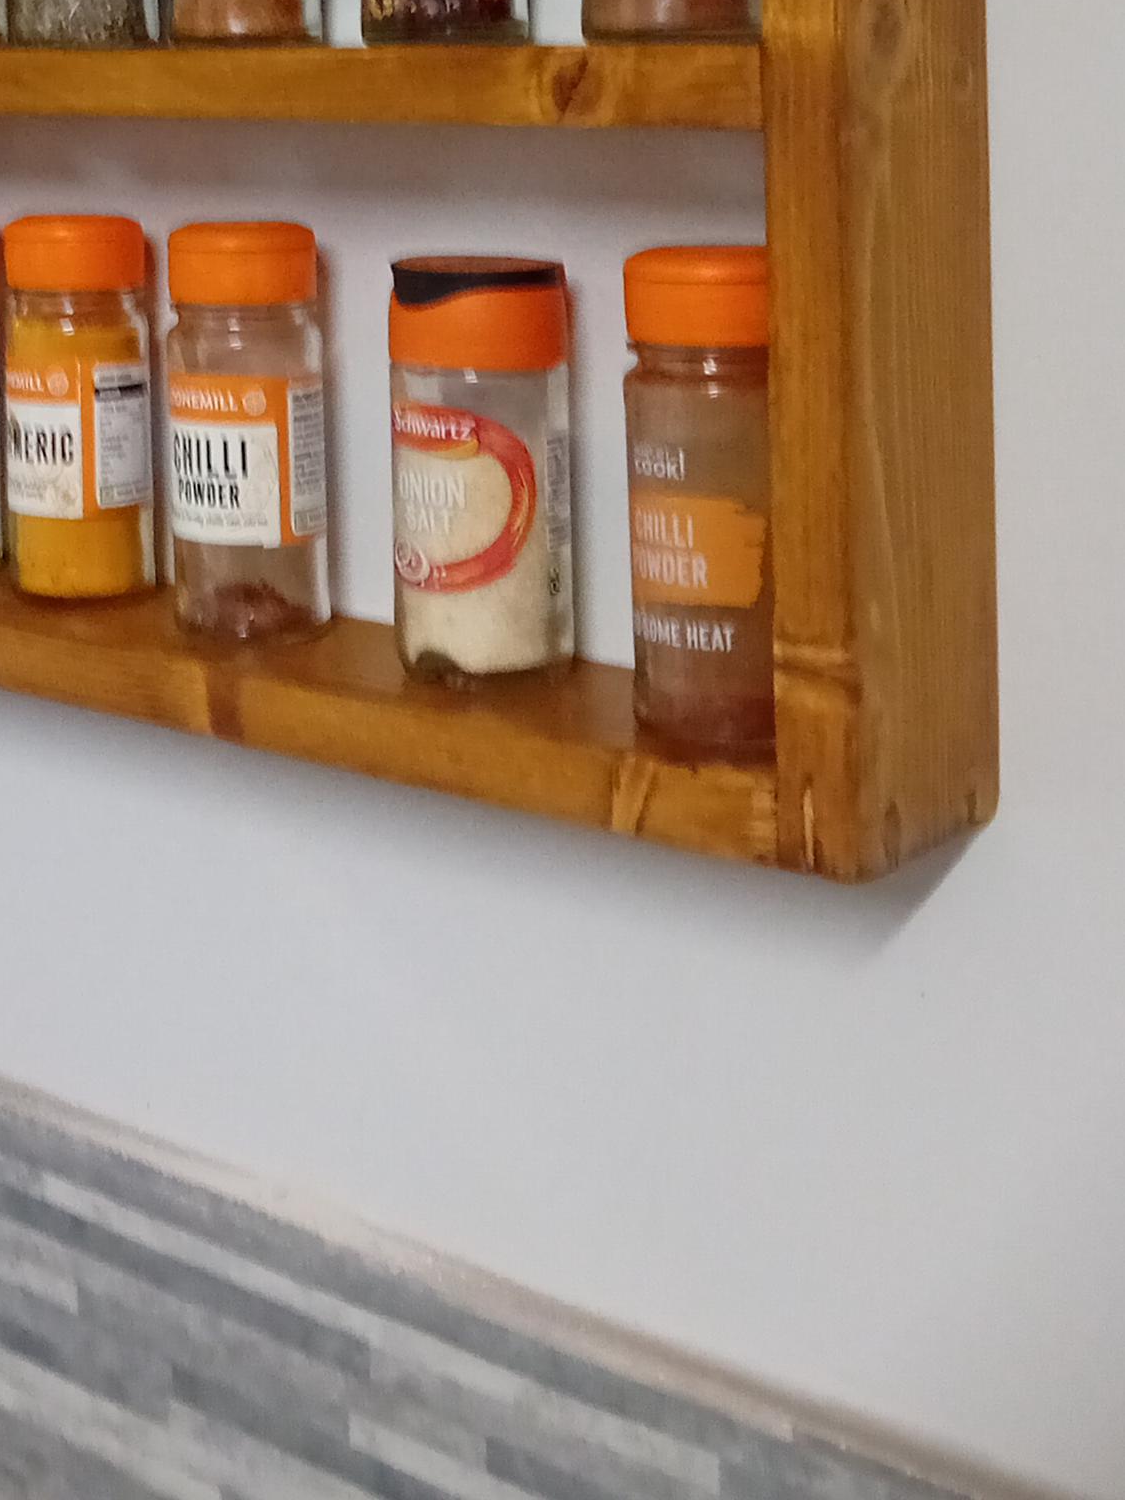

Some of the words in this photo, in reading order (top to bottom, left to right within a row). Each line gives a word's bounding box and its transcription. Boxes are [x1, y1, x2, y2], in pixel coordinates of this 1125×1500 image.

[393, 404, 476, 441] Schwartz
[174, 430, 249, 479] CHILLI
[178, 478, 241, 510] POWDER
[399, 467, 467, 510] ONION
[686, 616, 735, 653] HEAT
